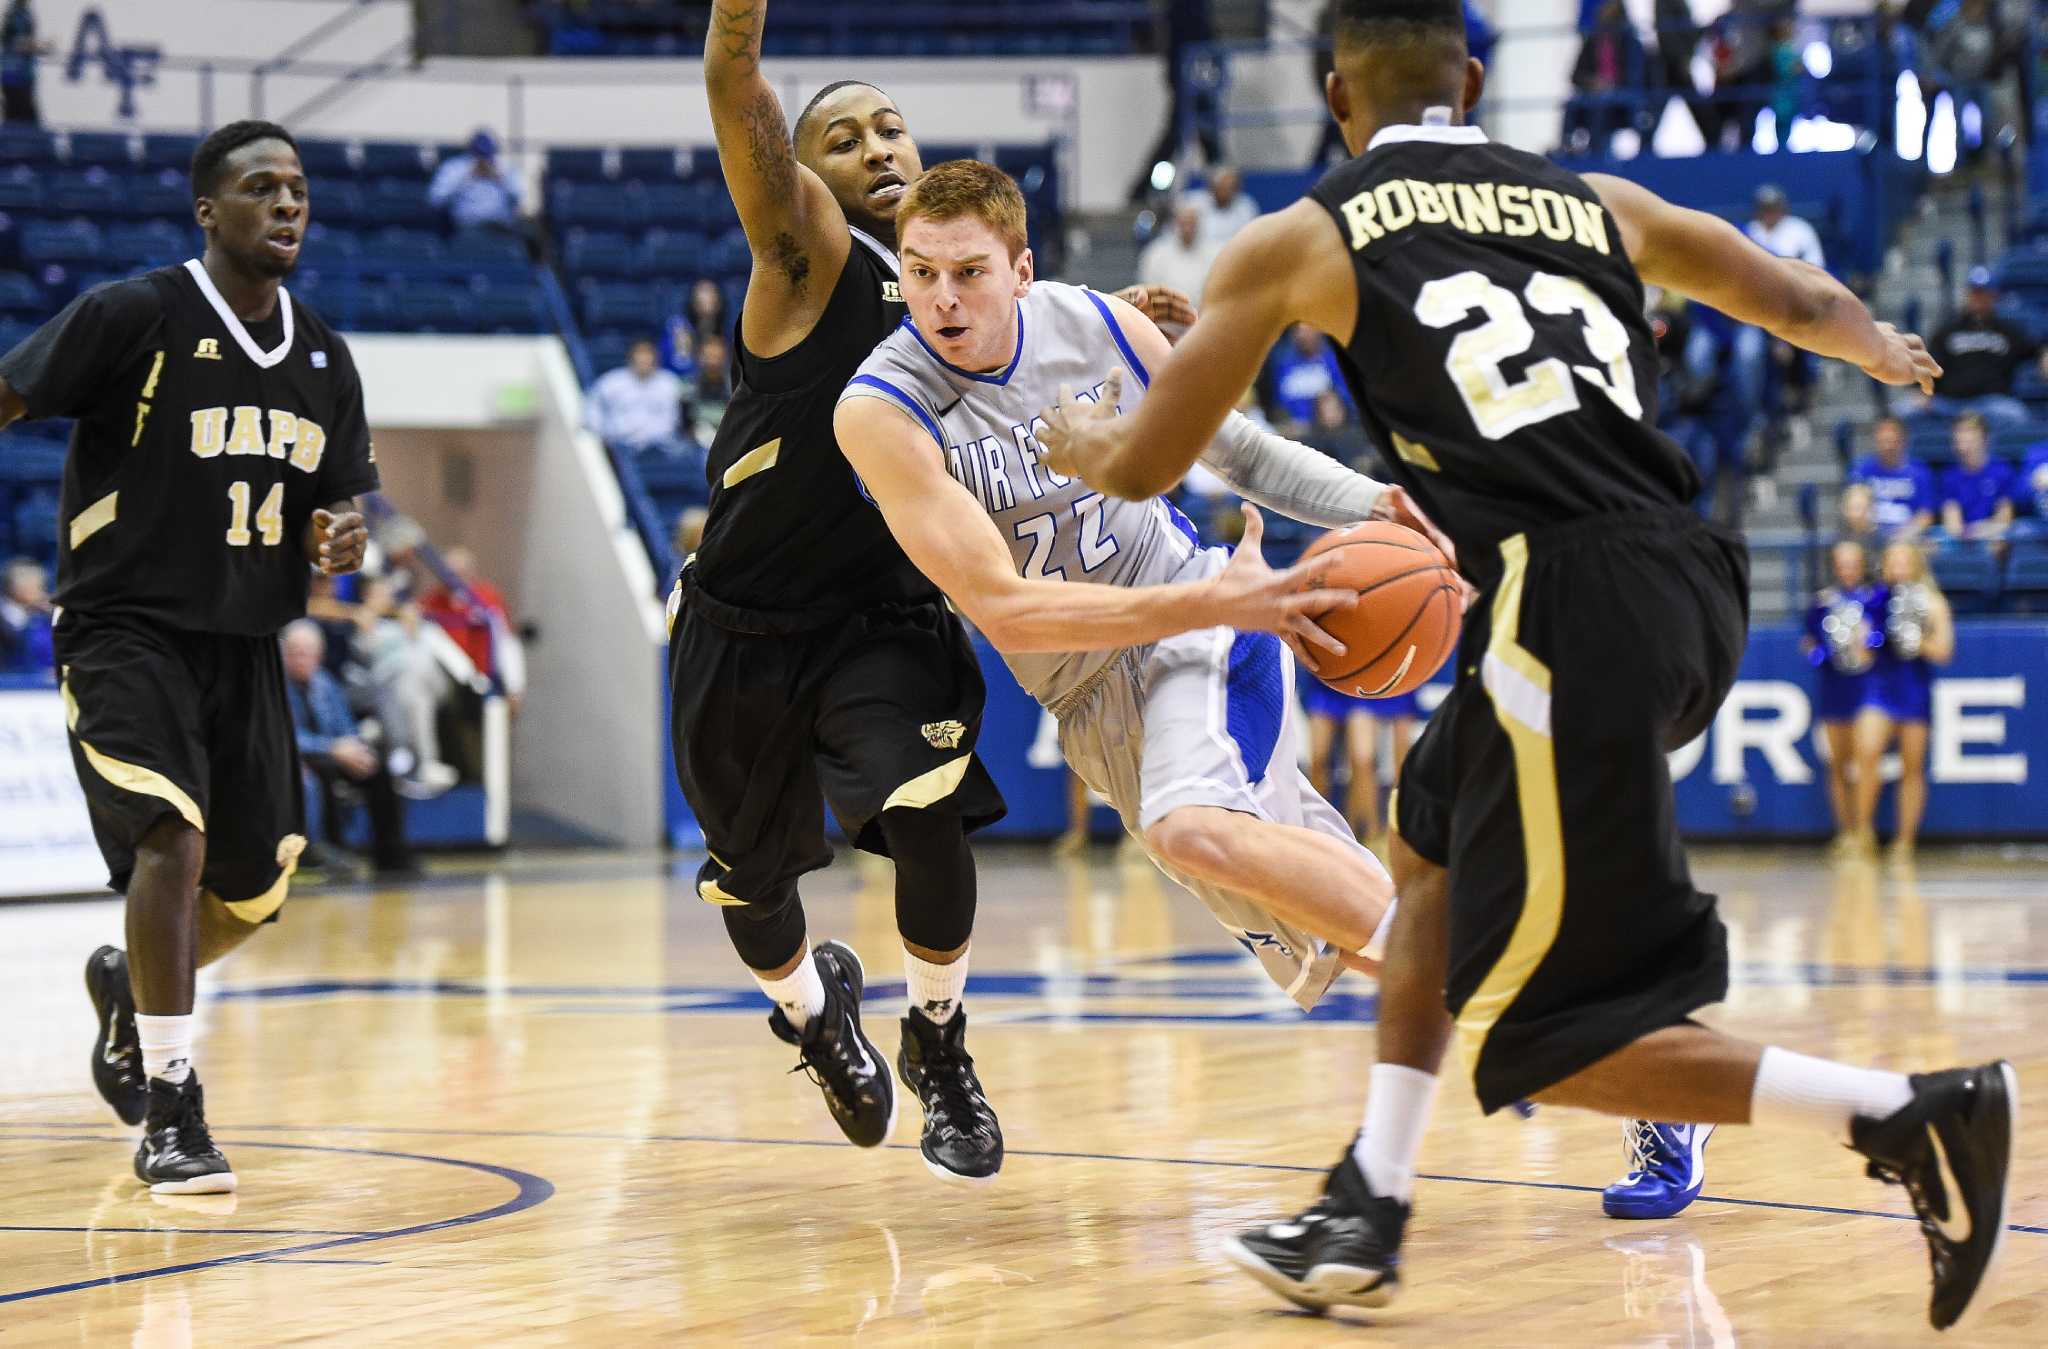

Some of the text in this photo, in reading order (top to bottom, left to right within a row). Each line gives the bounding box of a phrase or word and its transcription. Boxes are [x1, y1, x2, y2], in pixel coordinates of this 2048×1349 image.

[1341, 178, 1610, 254] ROBINSON
[1413, 270, 1643, 441] 23
[190, 406, 326, 473] UAPB
[226, 481, 285, 546] 14
[1014, 492, 1120, 582] 22
